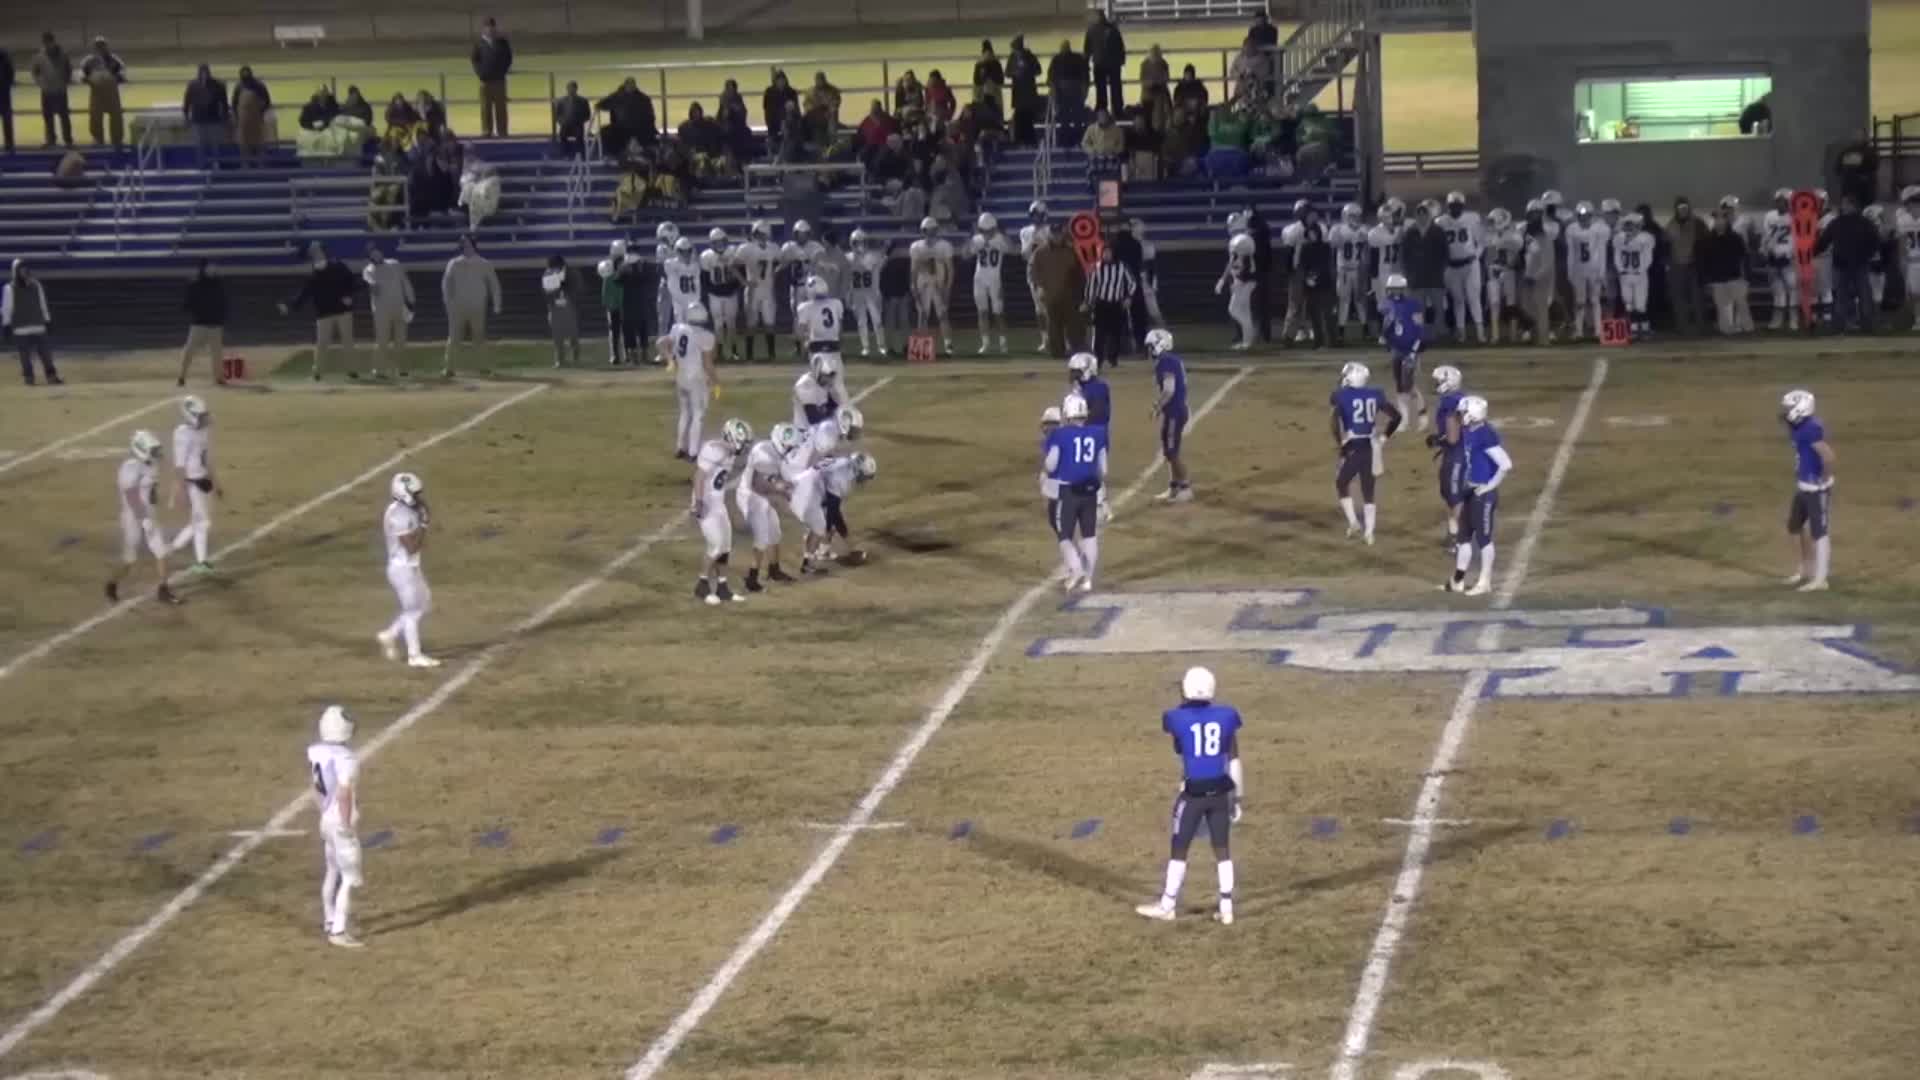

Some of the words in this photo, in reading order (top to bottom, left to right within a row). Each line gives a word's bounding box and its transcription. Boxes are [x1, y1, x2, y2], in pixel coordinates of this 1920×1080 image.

[821, 307, 834, 329] 3
[1602, 321, 1626, 341] 50
[1352, 397, 1377, 424] 20
[1073, 437, 1096, 464] 13
[713, 469, 728, 492] 6
[1190, 721, 1222, 758] 18
